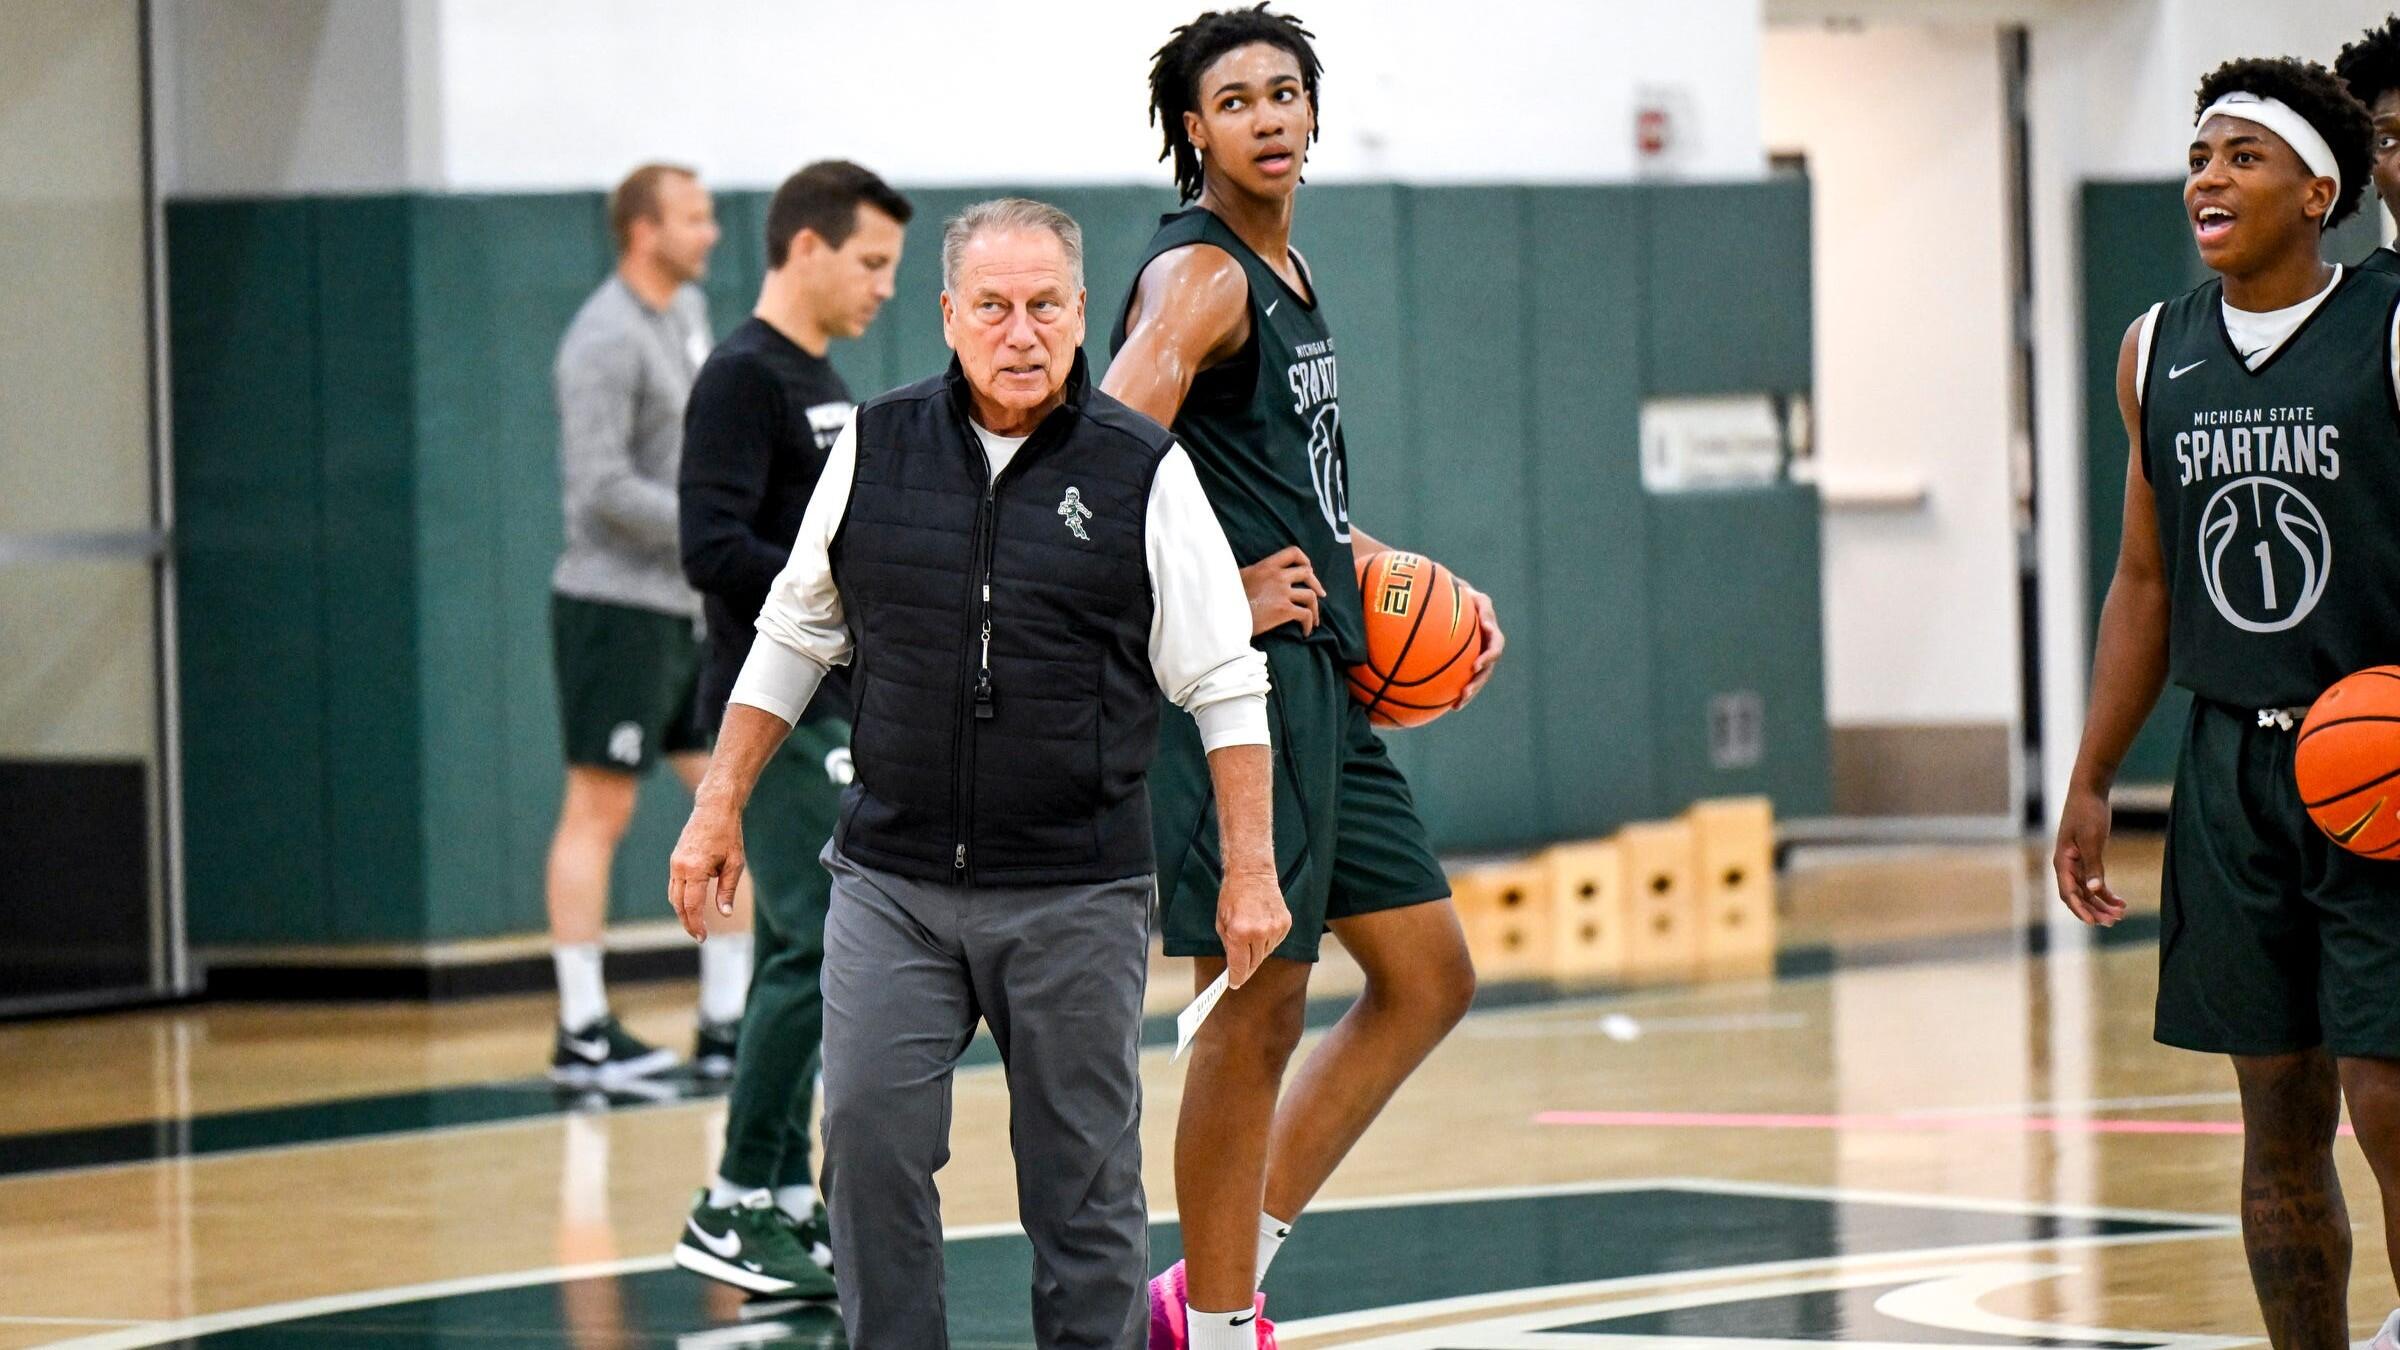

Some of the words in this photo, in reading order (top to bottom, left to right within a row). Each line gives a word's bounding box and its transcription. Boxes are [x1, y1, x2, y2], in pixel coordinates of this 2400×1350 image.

[2194, 408, 2262, 426] MICHIGAN
[2270, 406, 2314, 421] STATE
[2175, 424, 2340, 487] SPARTANS
[1381, 553, 1419, 616] ELITE
[2254, 540, 2277, 610] 1
